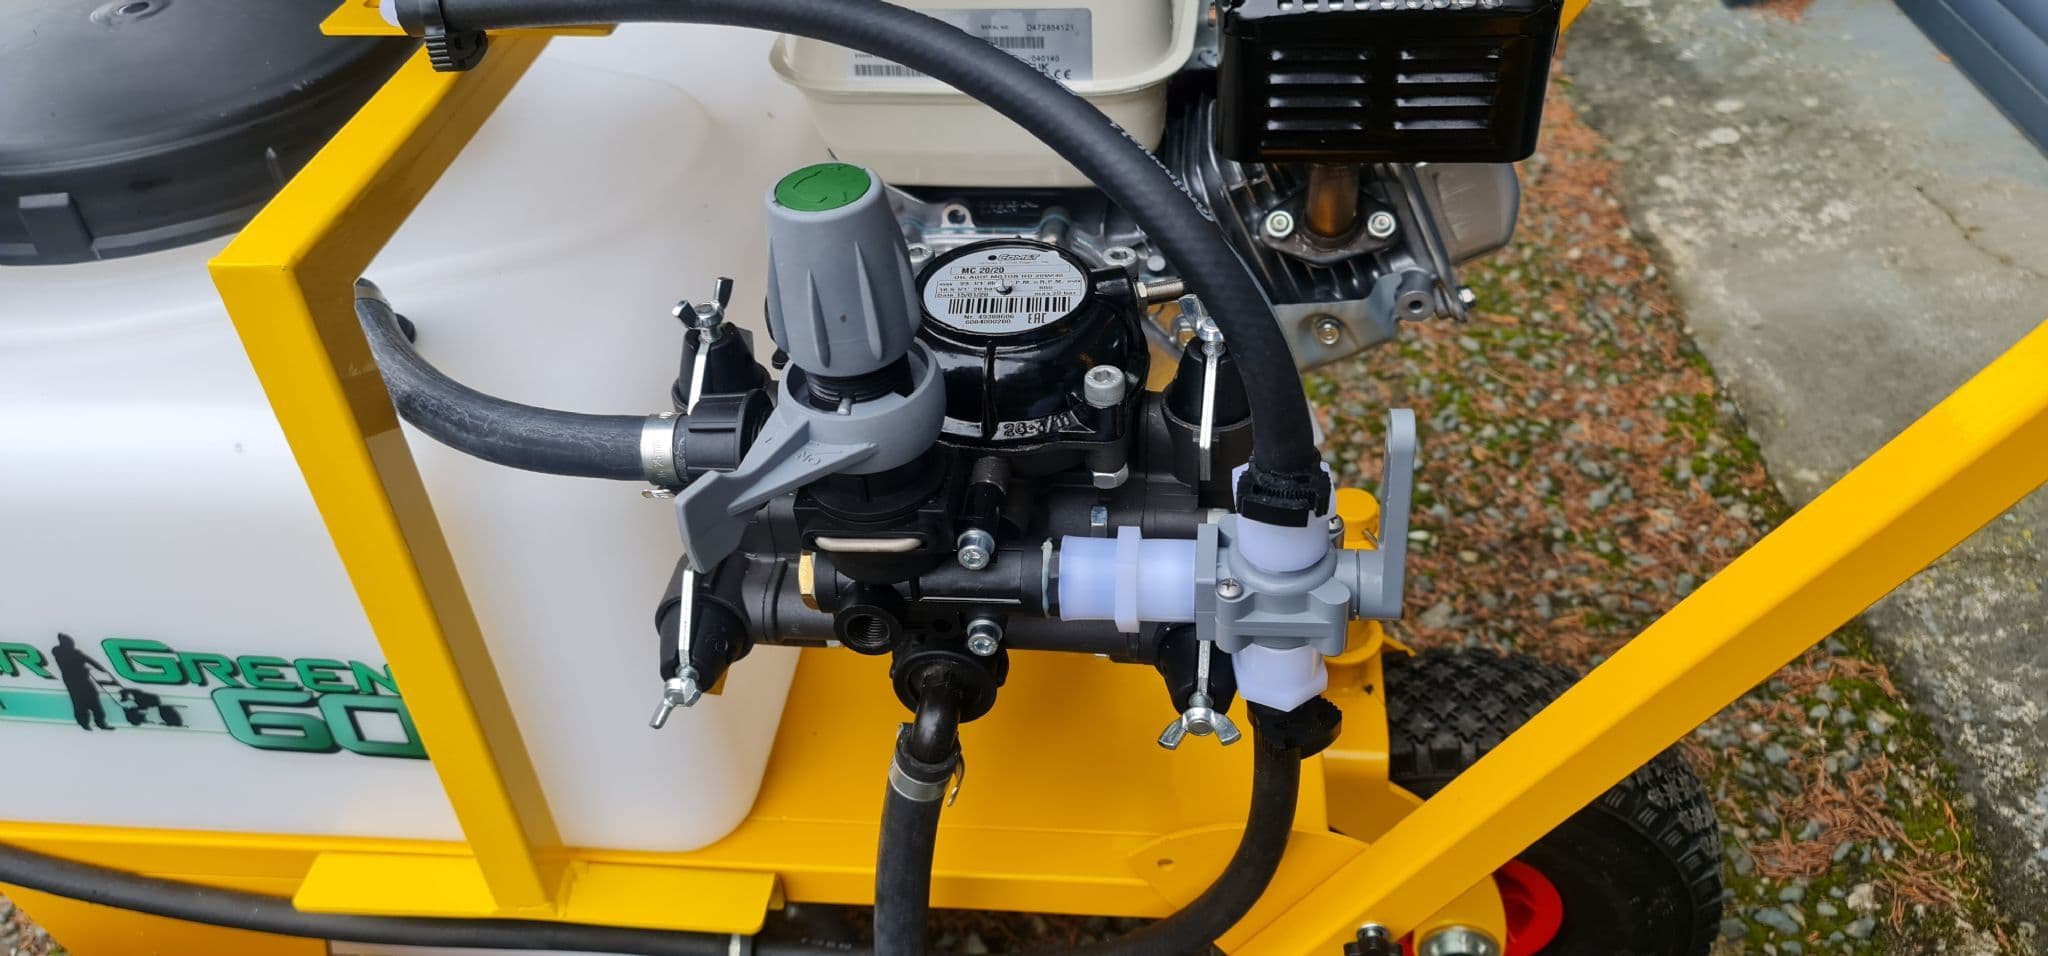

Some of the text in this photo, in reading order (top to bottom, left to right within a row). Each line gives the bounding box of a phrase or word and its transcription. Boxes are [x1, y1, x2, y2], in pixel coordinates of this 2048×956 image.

[997, 253, 1041, 262] COMET
[101, 637, 402, 695] GREEN
[210, 687, 432, 761] 60
